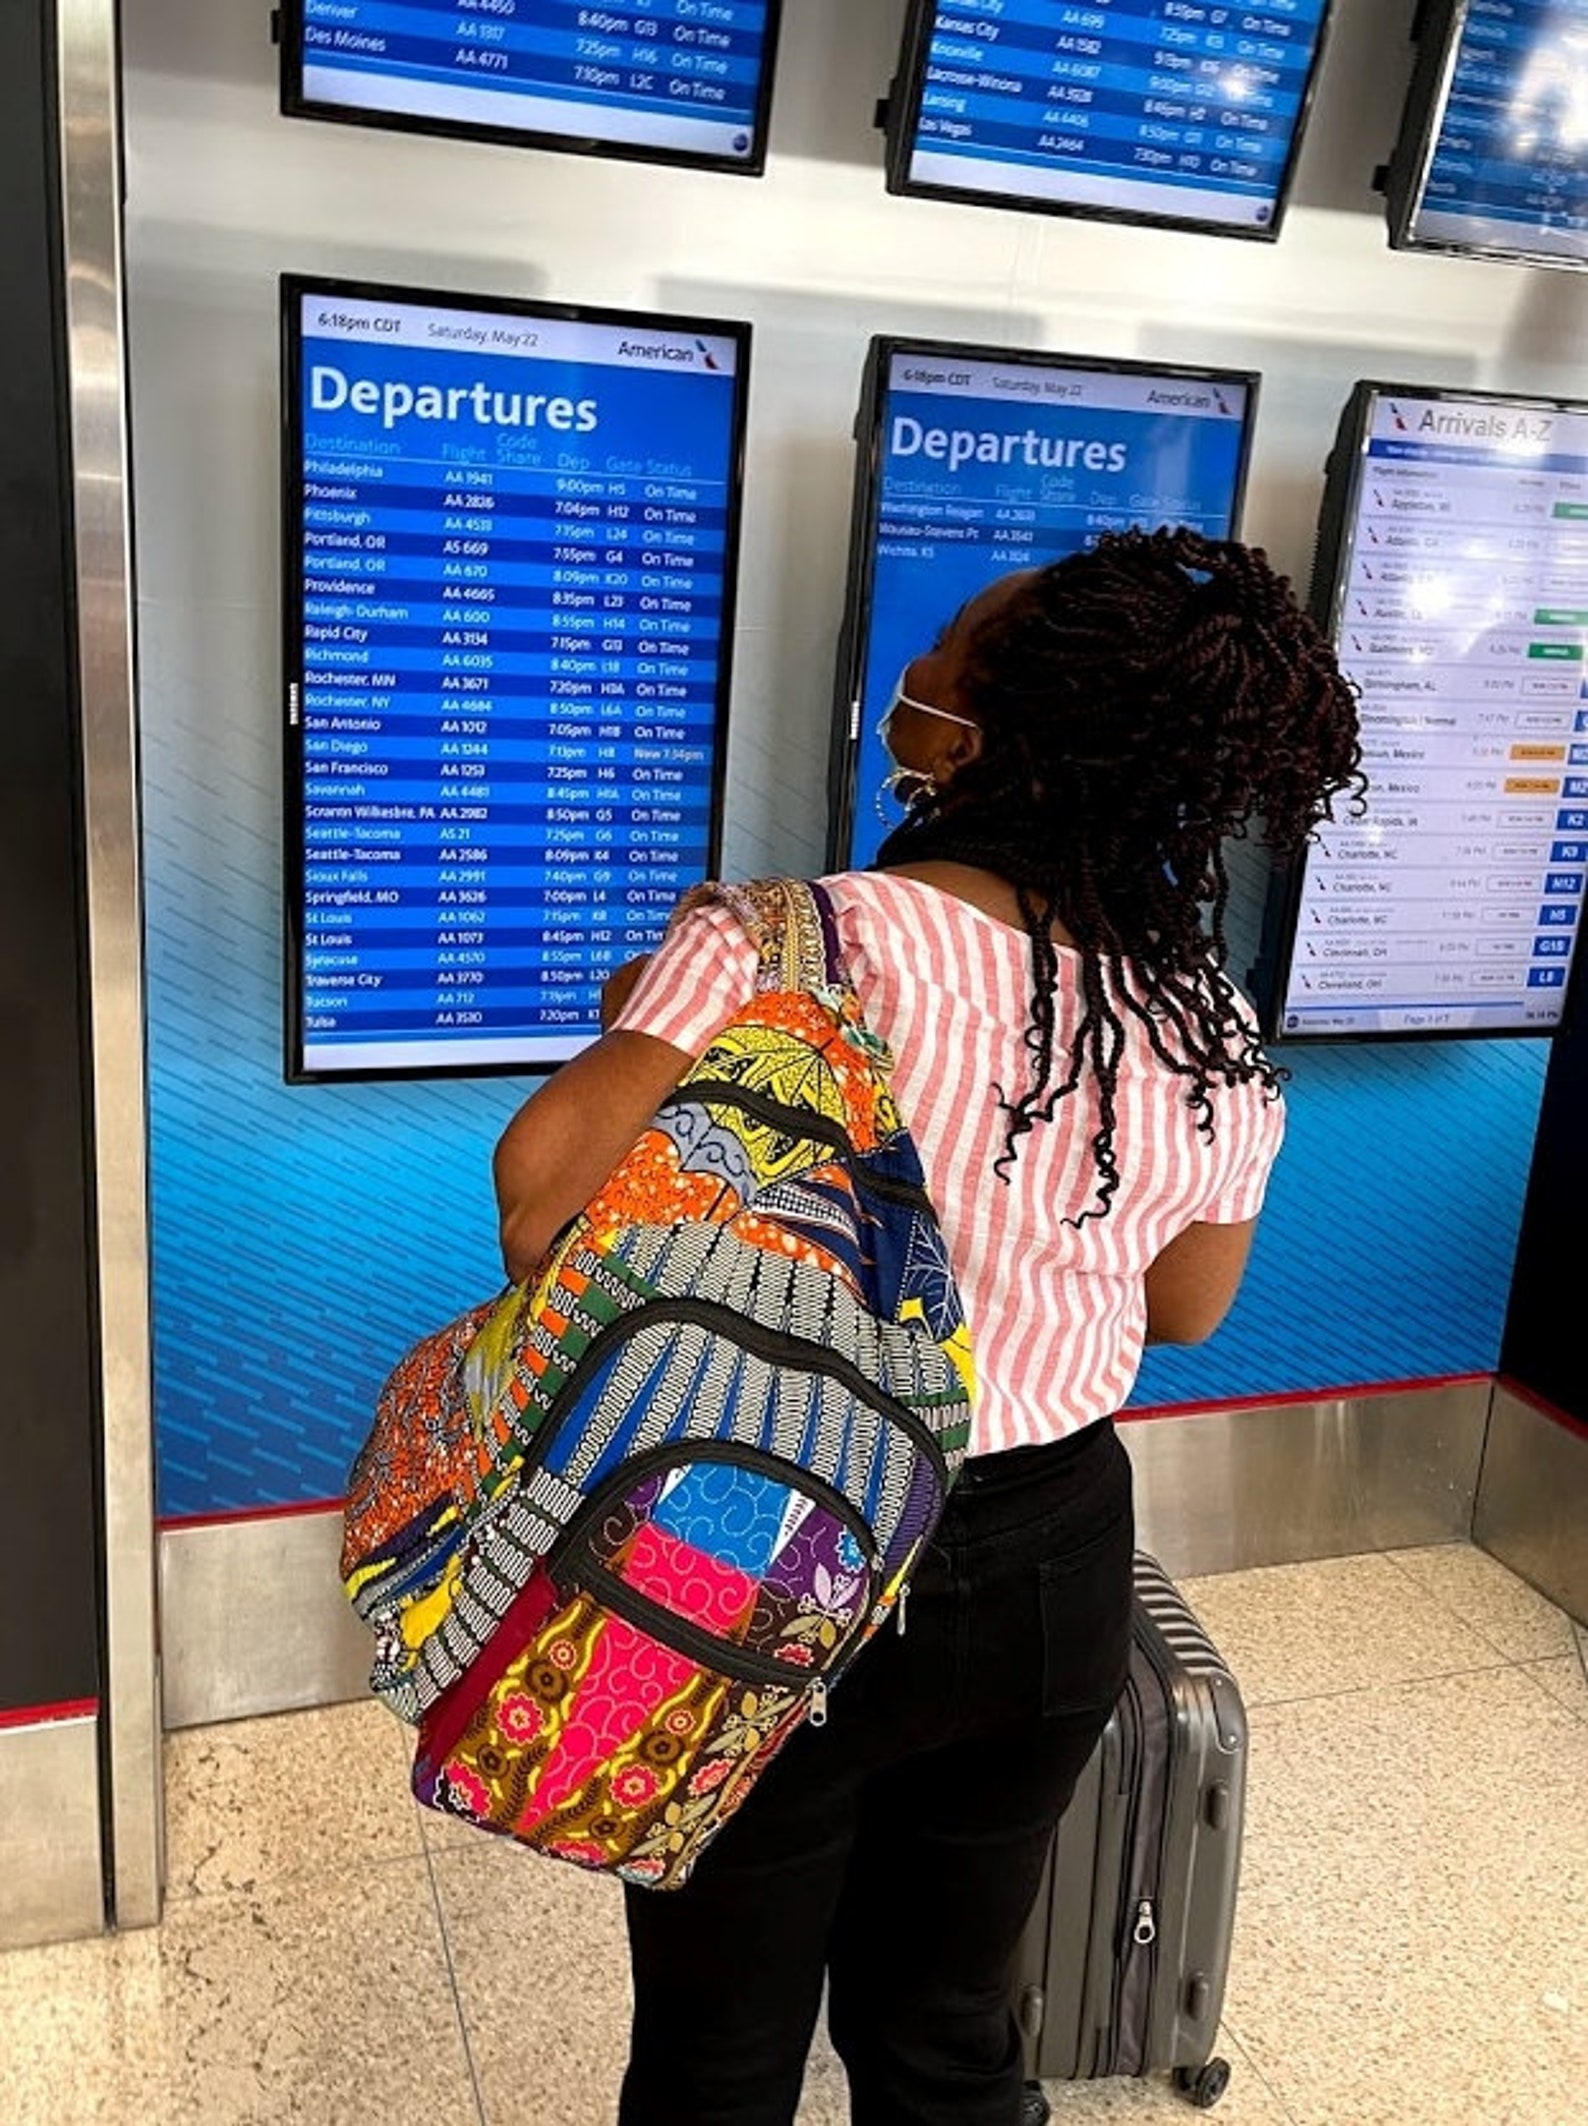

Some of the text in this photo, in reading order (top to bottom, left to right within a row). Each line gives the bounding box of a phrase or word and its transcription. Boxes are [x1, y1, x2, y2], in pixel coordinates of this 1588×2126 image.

[673, 25, 731, 48] On Time
[935, 15, 1000, 41] Kansas City
[305, 26, 332, 44] Des
[334, 31, 386, 52] Moines
[456, 49, 475, 64] AA
[669, 79, 691, 96] On
[693, 82, 725, 100] Time
[318, 313, 370, 331] 6:18pm
[374, 318, 401, 332] CDT
[492, 330, 522, 347] May
[523, 332, 538, 347] 22
[617, 341, 694, 362] American
[311, 366, 598, 432] Departures
[948, 374, 972, 386] CDT
[1146, 390, 1211, 408] American
[1418, 409, 1553, 442] Arrivals A-Z
[892, 416, 1126, 472] Departures
[557, 454, 590, 471] Dep
[304, 460, 383, 479] Philadelphia
[446, 471, 464, 483] AA
[645, 484, 665, 498] On
[666, 486, 697, 500] Time
[304, 484, 357, 499] Phoenix
[644, 507, 663, 521] On
[666, 509, 696, 523] Time
[304, 507, 370, 526] Pittsburgh
[365, 535, 386, 549] OR
[444, 540, 461, 554] AS
[606, 550, 623, 563] G4
[642, 552, 661, 565] On
[663, 553, 694, 567] Time
[365, 559, 385, 572] OR
[444, 564, 462, 576] AA
[305, 579, 692, 612] Providence On Time
[443, 610, 462, 622] AA
[464, 610, 490, 623] 600
[305, 625, 340, 641] Rapid
[343, 627, 368, 643] City
[443, 632, 462, 644] AA
[638, 640, 658, 653] On
[659, 642, 689, 655] Time
[304, 647, 368, 663] Richmond
[443, 654, 461, 666] AA
[372, 674, 396, 686] MN
[636, 683, 656, 696] On
[658, 684, 687, 697] Time
[372, 696, 390, 708] NY
[305, 716, 685, 740] San Antonio On Time
[305, 739, 368, 755] San Diego
[306, 761, 329, 773] San
[331, 762, 388, 775] Francisco
[632, 768, 652, 781] On
[654, 768, 683, 781] Time
[305, 782, 365, 796] Savannah
[632, 809, 650, 822] On
[652, 809, 681, 821] Time
[305, 826, 400, 839] Seattle-Tacoma
[440, 828, 456, 839] AS
[458, 828, 470, 840] 21
[306, 849, 401, 860] Seattle-Tacoma
[440, 849, 457, 860] AA
[629, 850, 647, 862] On
[650, 850, 679, 862] Time
[341, 870, 368, 882] Falls
[376, 891, 399, 903] MO
[627, 890, 645, 903] On
[648, 890, 676, 902] Time
[305, 912, 318, 924] St
[321, 912, 352, 924] Louis
[438, 912, 456, 923] AA
[306, 933, 318, 946] St
[321, 934, 352, 946] Louis
[438, 933, 456, 944] AA
[438, 953, 455, 964] AA
[357, 973, 383, 987] City
[305, 994, 347, 1008] Tucson
[305, 1016, 336, 1028] Tulsa
